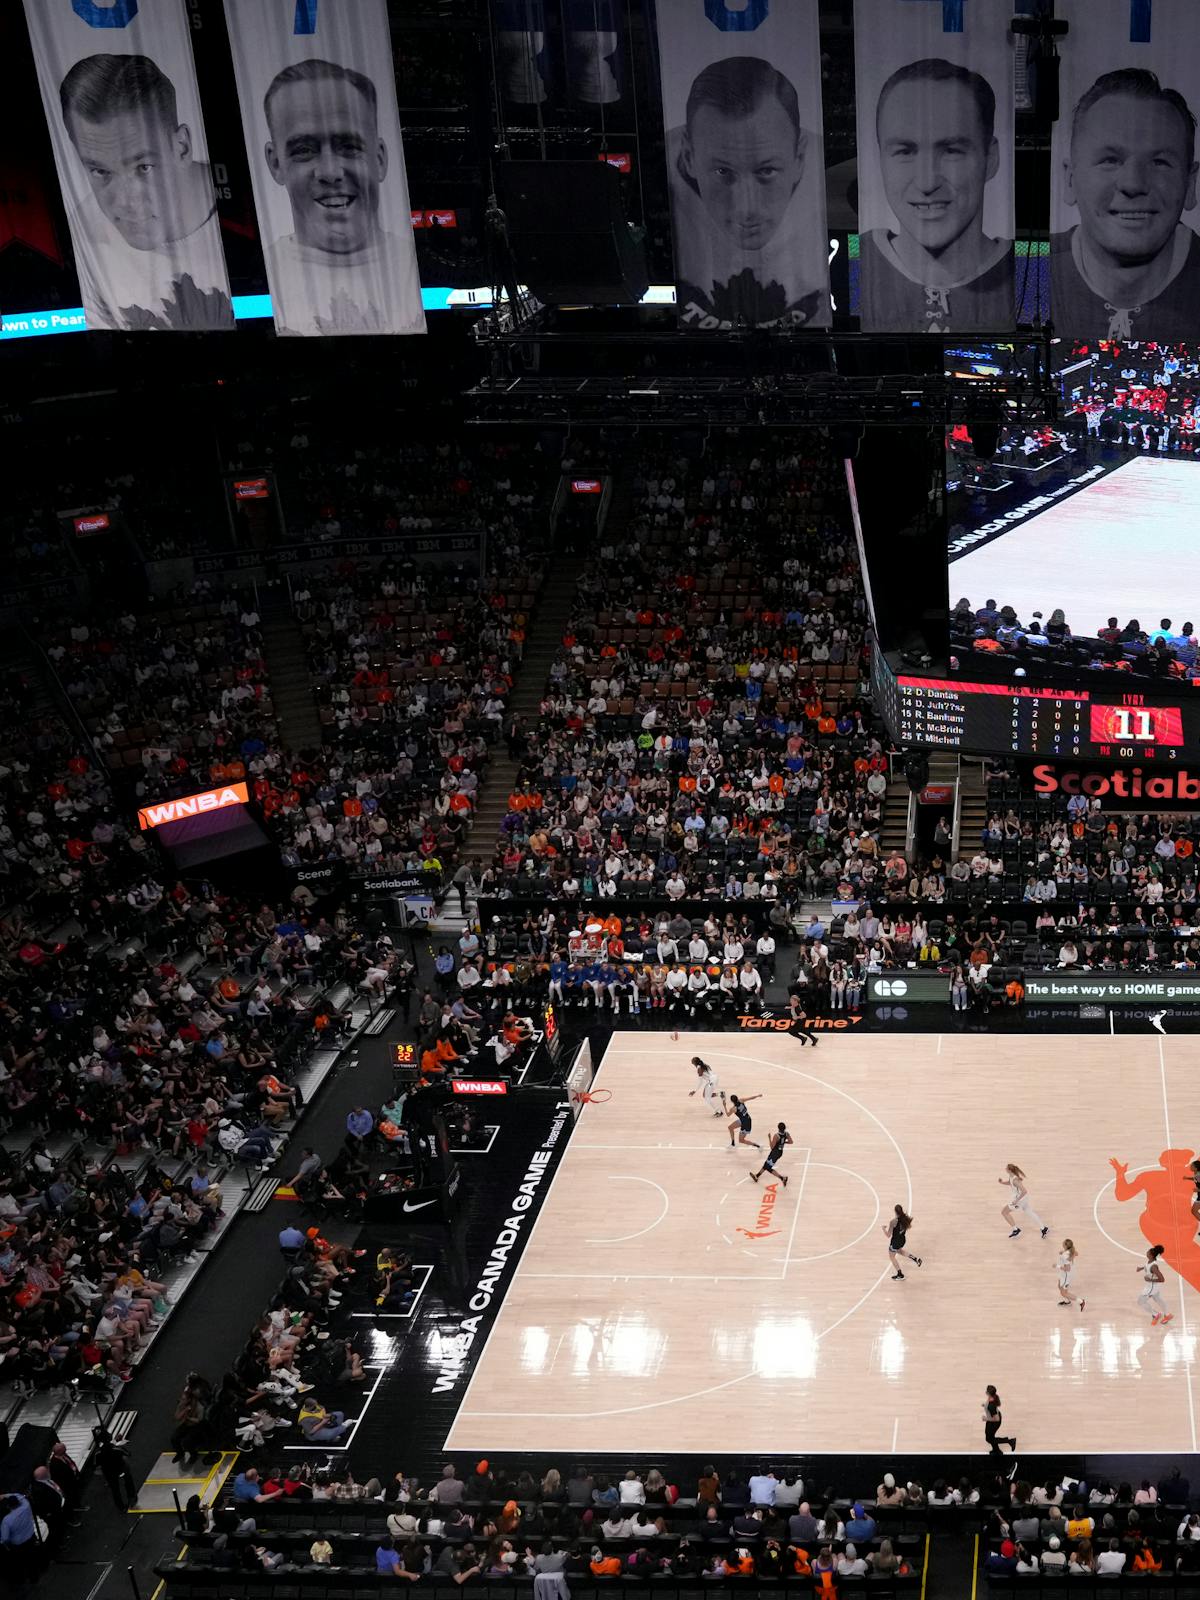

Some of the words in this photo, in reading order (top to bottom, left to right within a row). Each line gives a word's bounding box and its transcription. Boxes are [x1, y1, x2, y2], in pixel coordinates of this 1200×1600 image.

[31, 318, 48, 328] to
[902, 687, 912, 696] 12
[915, 688, 925, 697] D.
[927, 690, 959, 700] Dantas
[1033, 698, 1039, 707] 2
[901, 698, 912, 707] 14
[915, 700, 925, 709] D.
[1012, 708, 1019, 717] 2
[1032, 710, 1038, 718] 2
[1075, 713, 1080, 721] 1
[901, 709, 912, 718] 15
[915, 711, 925, 720] R.
[927, 712, 964, 723] Banham
[1031, 721, 1038, 729] 0
[901, 721, 911, 729] 21
[915, 722, 925, 731] K.
[927, 723, 964, 734] McBride
[1012, 731, 1018, 739] 3
[1031, 733, 1038, 741] 3
[1114, 710, 1155, 740] 11
[901, 732, 912, 741] 25
[916, 733, 923, 741] T.
[925, 734, 960, 745] Mitchell
[1012, 743, 1018, 751] 6
[1032, 743, 1037, 752] 1
[1119, 747, 1133, 758] 00
[1169, 750, 1176, 759] 3
[147, 788, 240, 824] WNBA
[297, 867, 332, 881] Scene
[364, 877, 420, 890] Scotiabank
[1026, 984, 1049, 995] The
[1052, 984, 1080, 995] best
[1081, 986, 1106, 998] way
[1108, 985, 1122, 995] to
[1125, 984, 1164, 995] HOME
[737, 1015, 849, 1031] Tangrine
[456, 1083, 503, 1091] WNBA
[756, 1183, 778, 1229] WNBA
[432, 1315, 483, 1393] WNBA
[469, 1214, 525, 1311] CANADA
[512, 1151, 553, 1212] GAME
[541, 1119, 566, 1148] Presented
[554, 1111, 570, 1119] by
